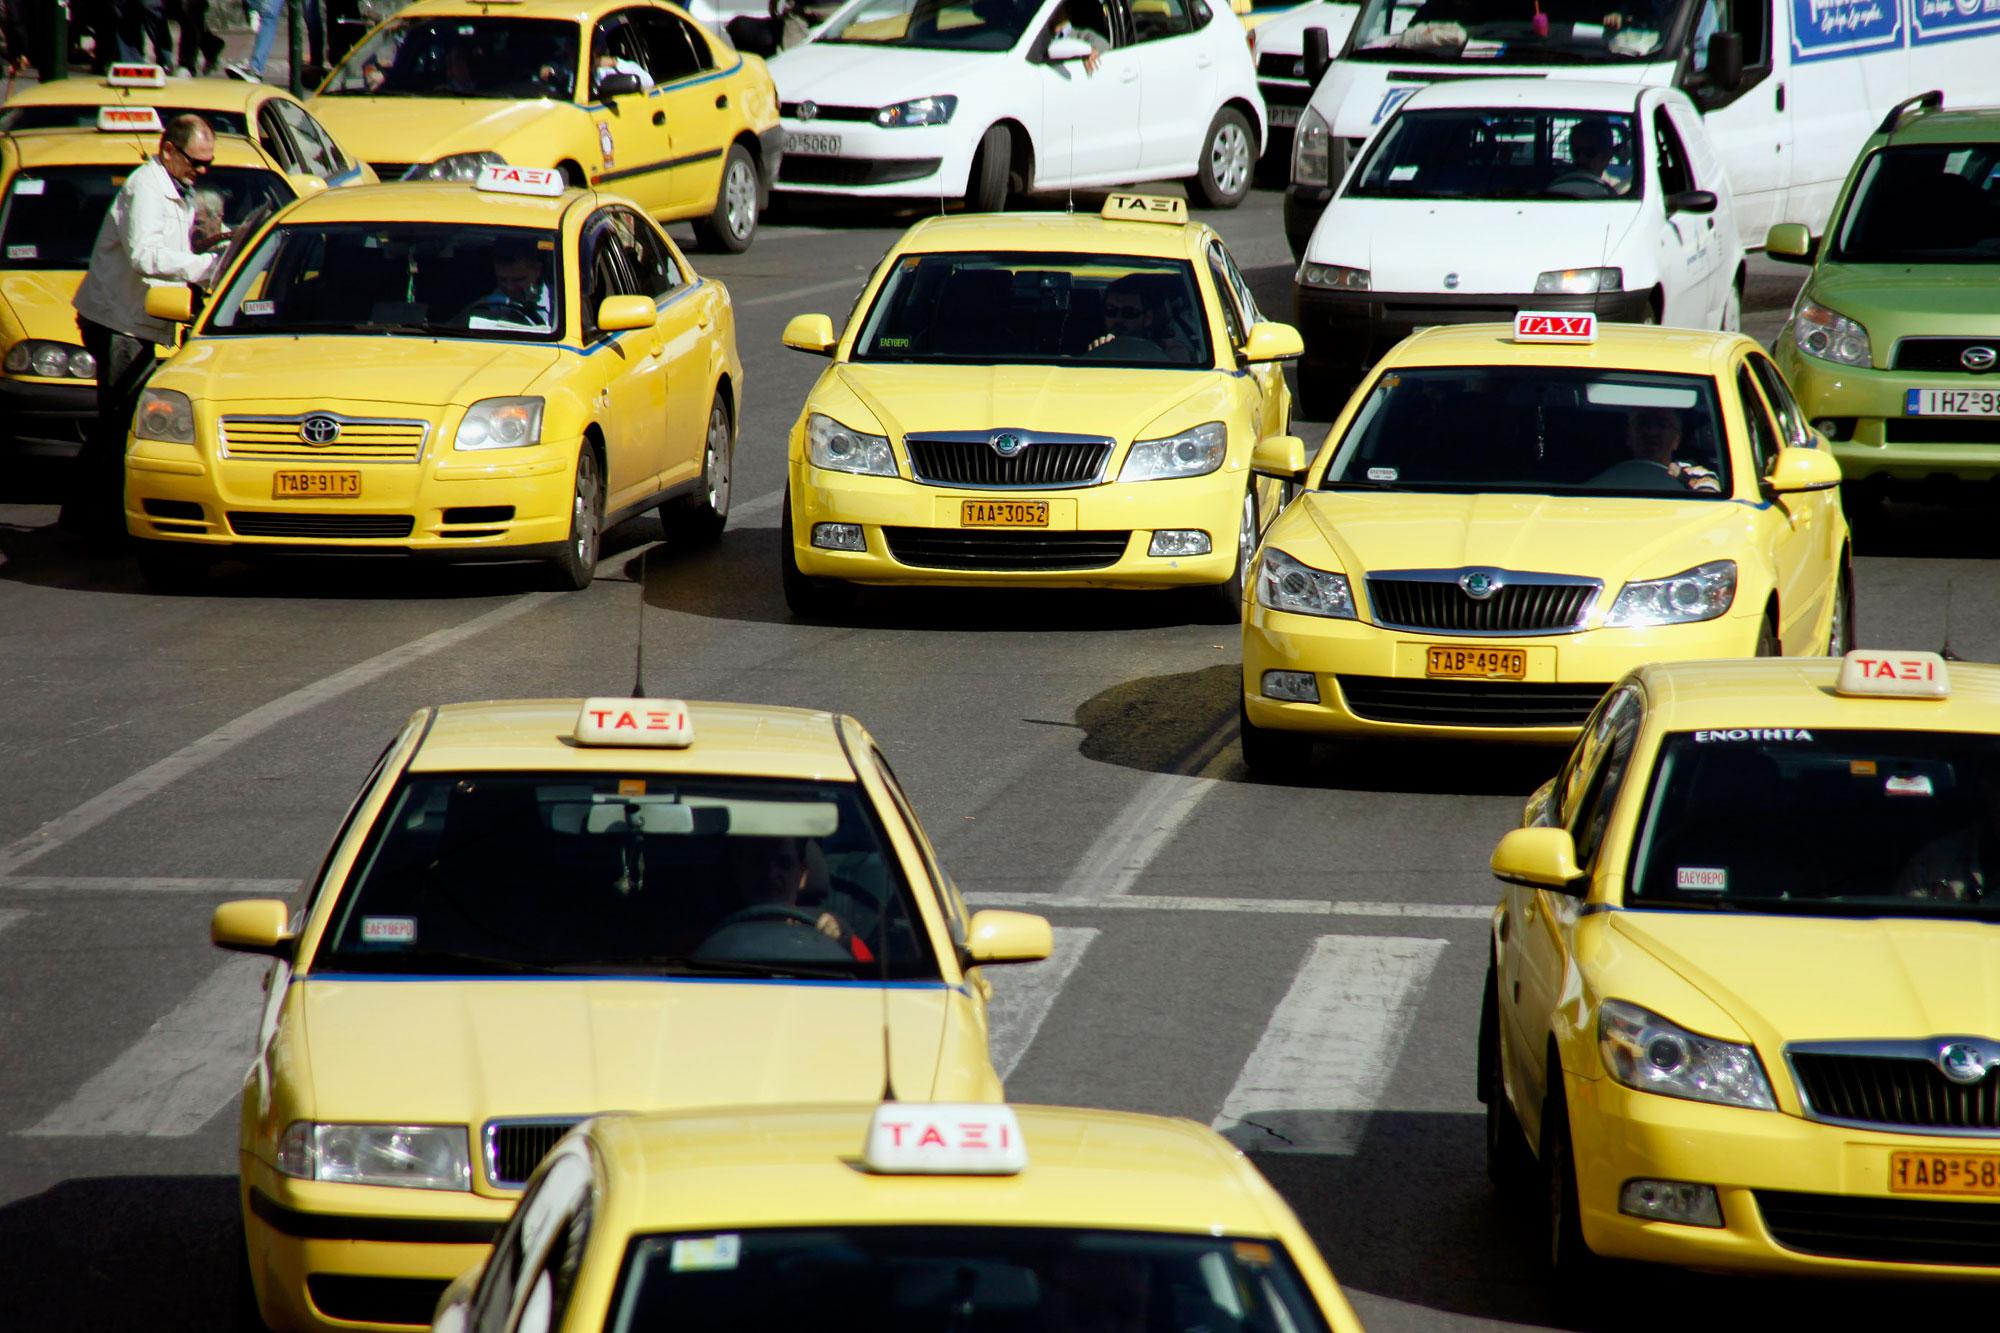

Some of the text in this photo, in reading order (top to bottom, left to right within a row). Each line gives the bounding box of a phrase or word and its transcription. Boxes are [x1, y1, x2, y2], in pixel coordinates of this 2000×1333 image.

[490, 167, 552, 184] ΤΑΞΙ
[1112, 196, 1178, 212] ΤΑΞΙ
[1520, 317, 1588, 334] TAXI
[1856, 659, 1933, 681] ΤΑΞΙ
[589, 711, 684, 731] ΤΑΞΙ
[881, 1122, 1009, 1149] ΤΑΞΙ
[1898, 1158, 2000, 1187] TAB-58
